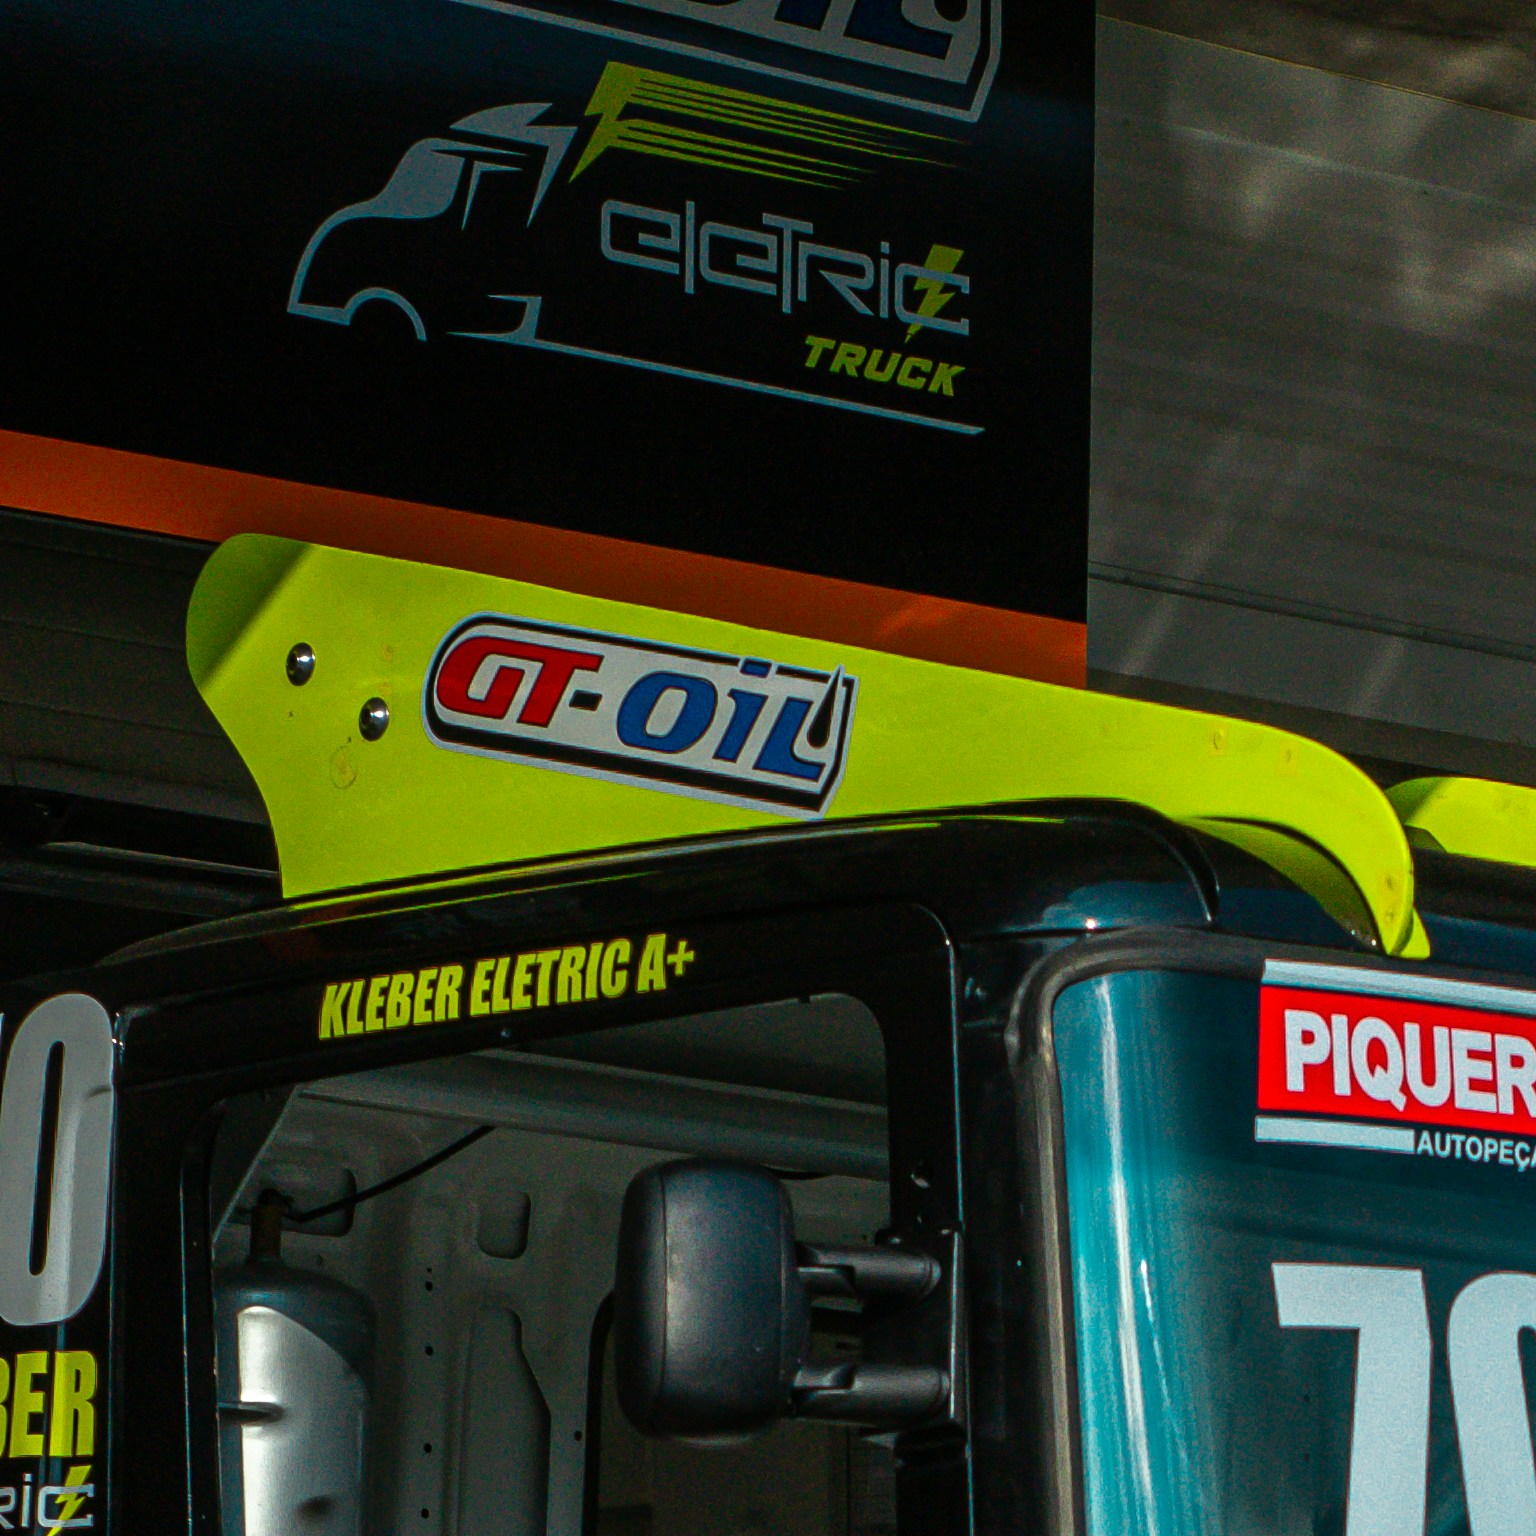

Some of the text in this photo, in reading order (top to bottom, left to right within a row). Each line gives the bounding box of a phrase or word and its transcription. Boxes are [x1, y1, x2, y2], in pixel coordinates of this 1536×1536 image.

[804, 334, 966, 397] TRUCK
[318, 933, 695, 1040] KLEBER ELETRIC A+
[0, 993, 114, 1326] 0
